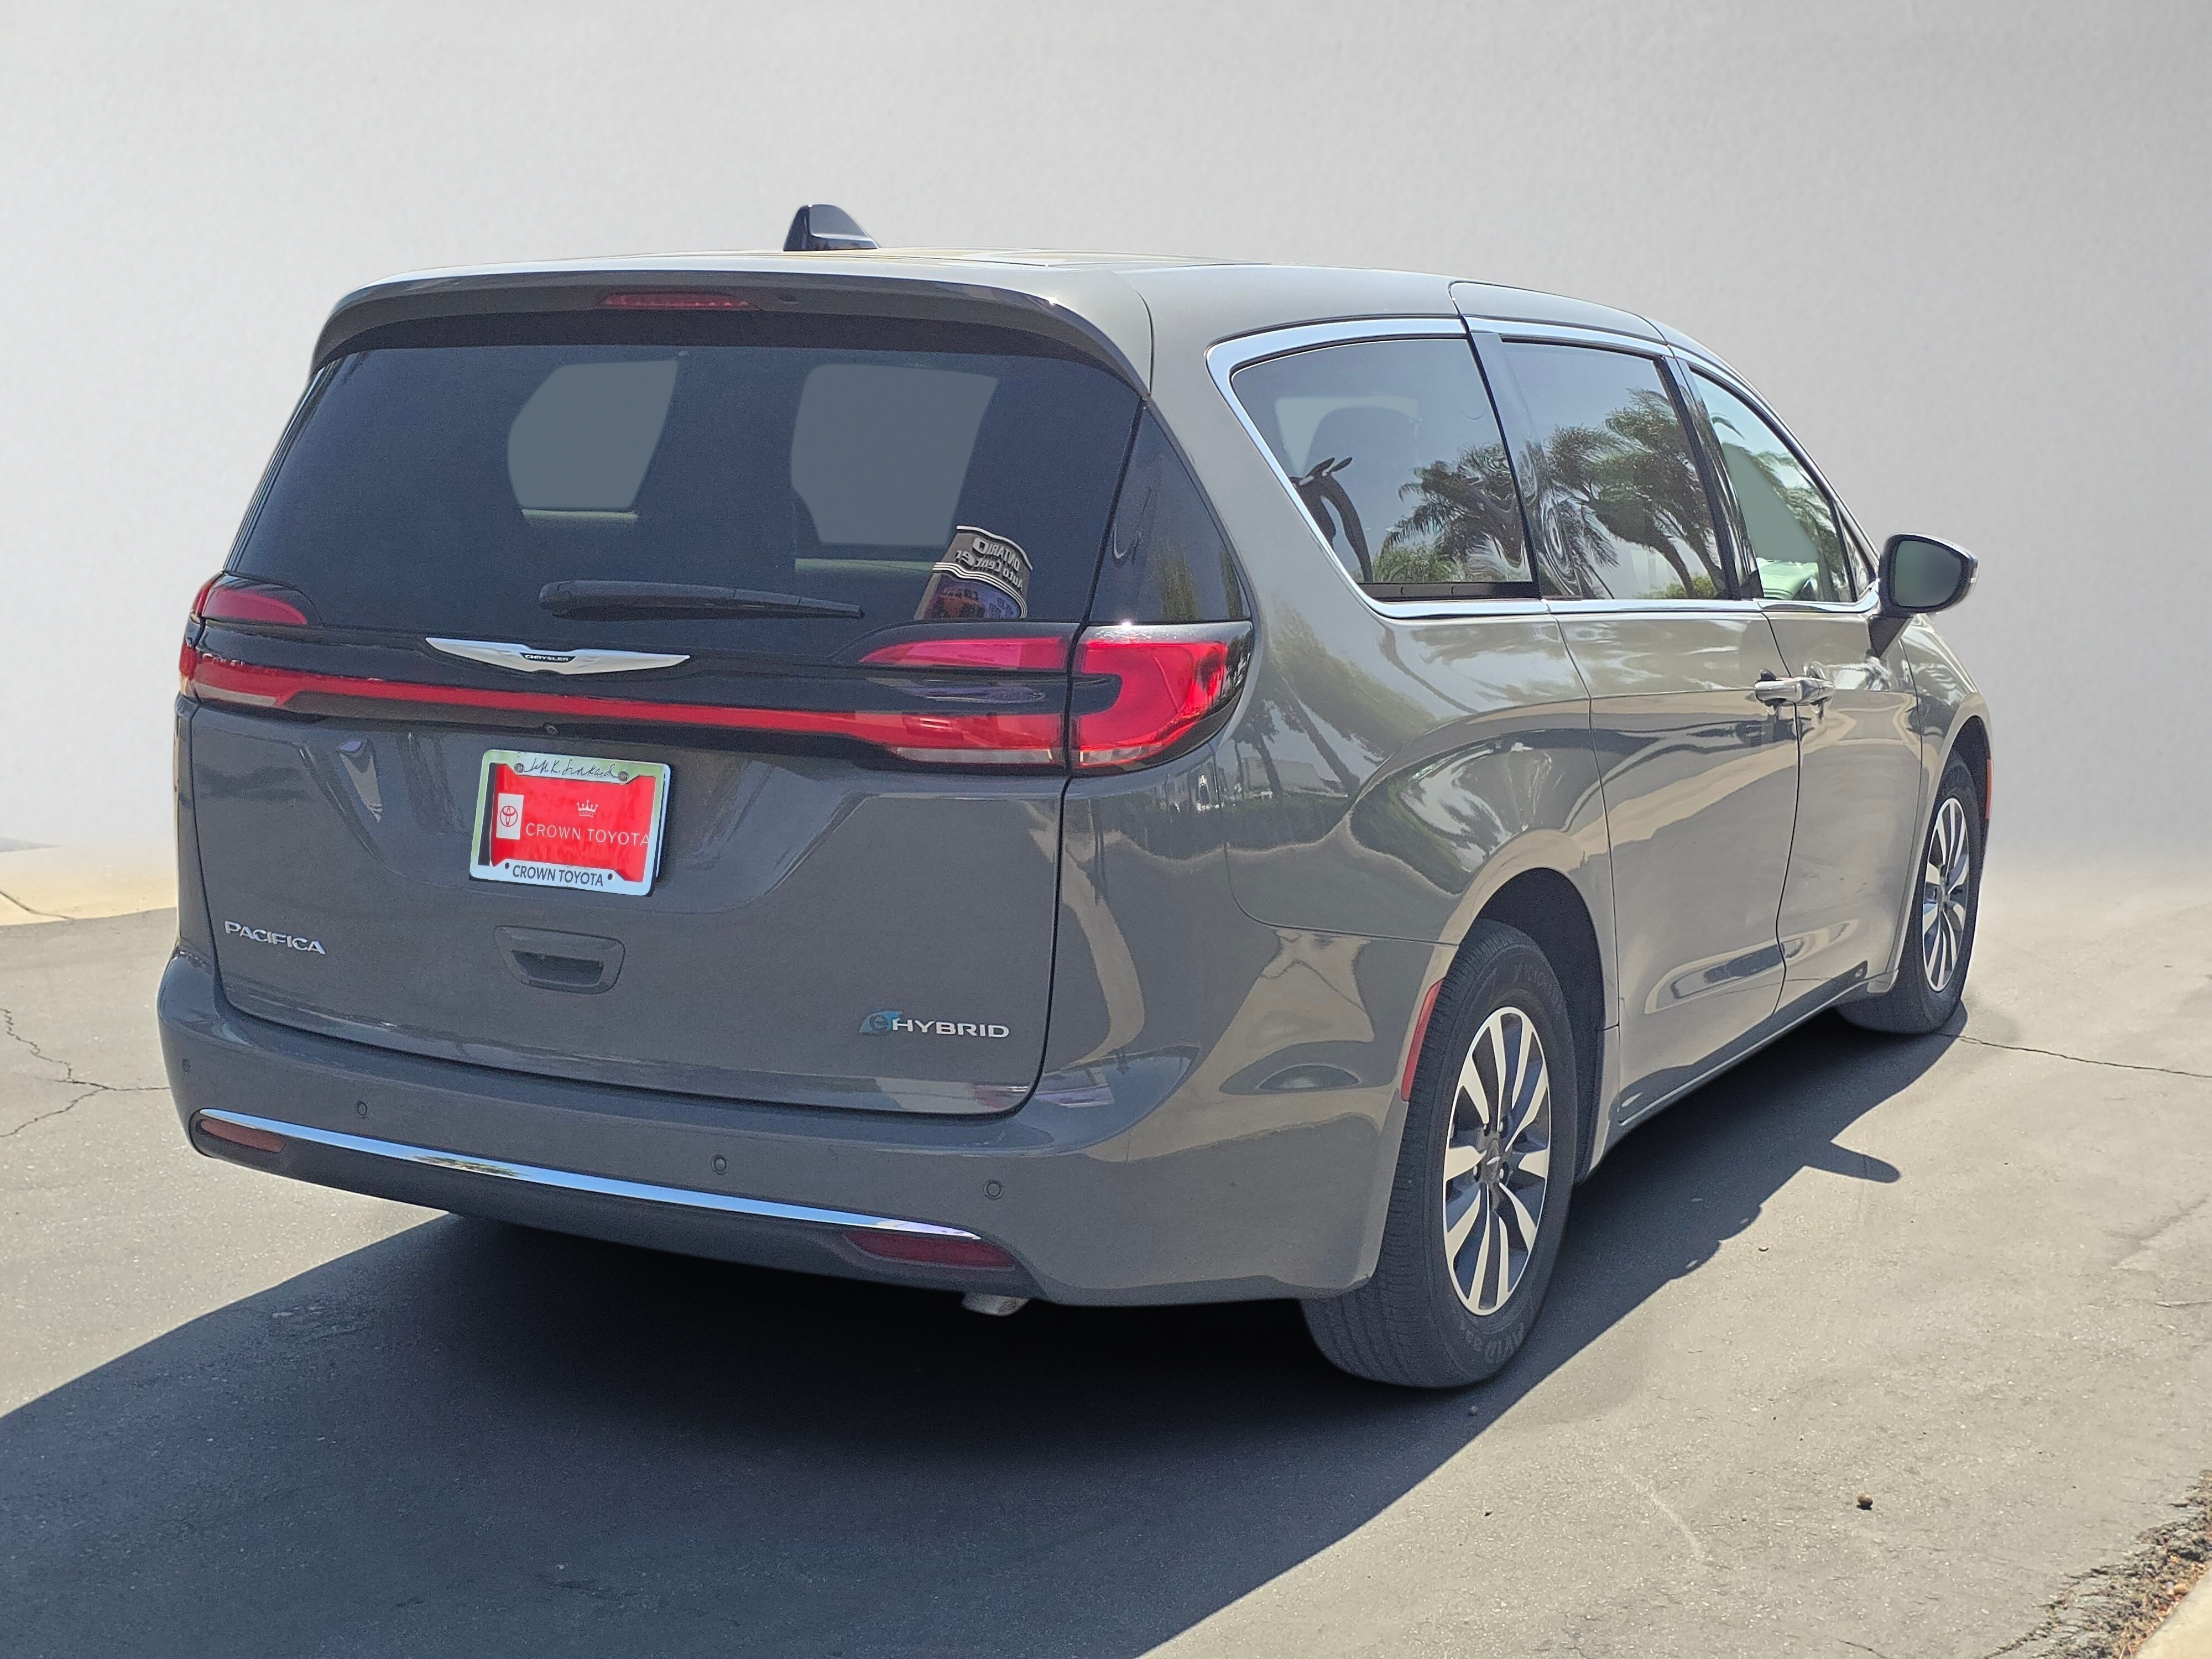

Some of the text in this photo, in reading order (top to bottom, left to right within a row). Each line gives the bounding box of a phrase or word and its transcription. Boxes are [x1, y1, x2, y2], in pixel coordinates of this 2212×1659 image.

[525, 822, 650, 847] CROWN TOYOTA
[512, 864, 604, 887] CROWN TOYOTA
[225, 920, 326, 955] PACIFICA
